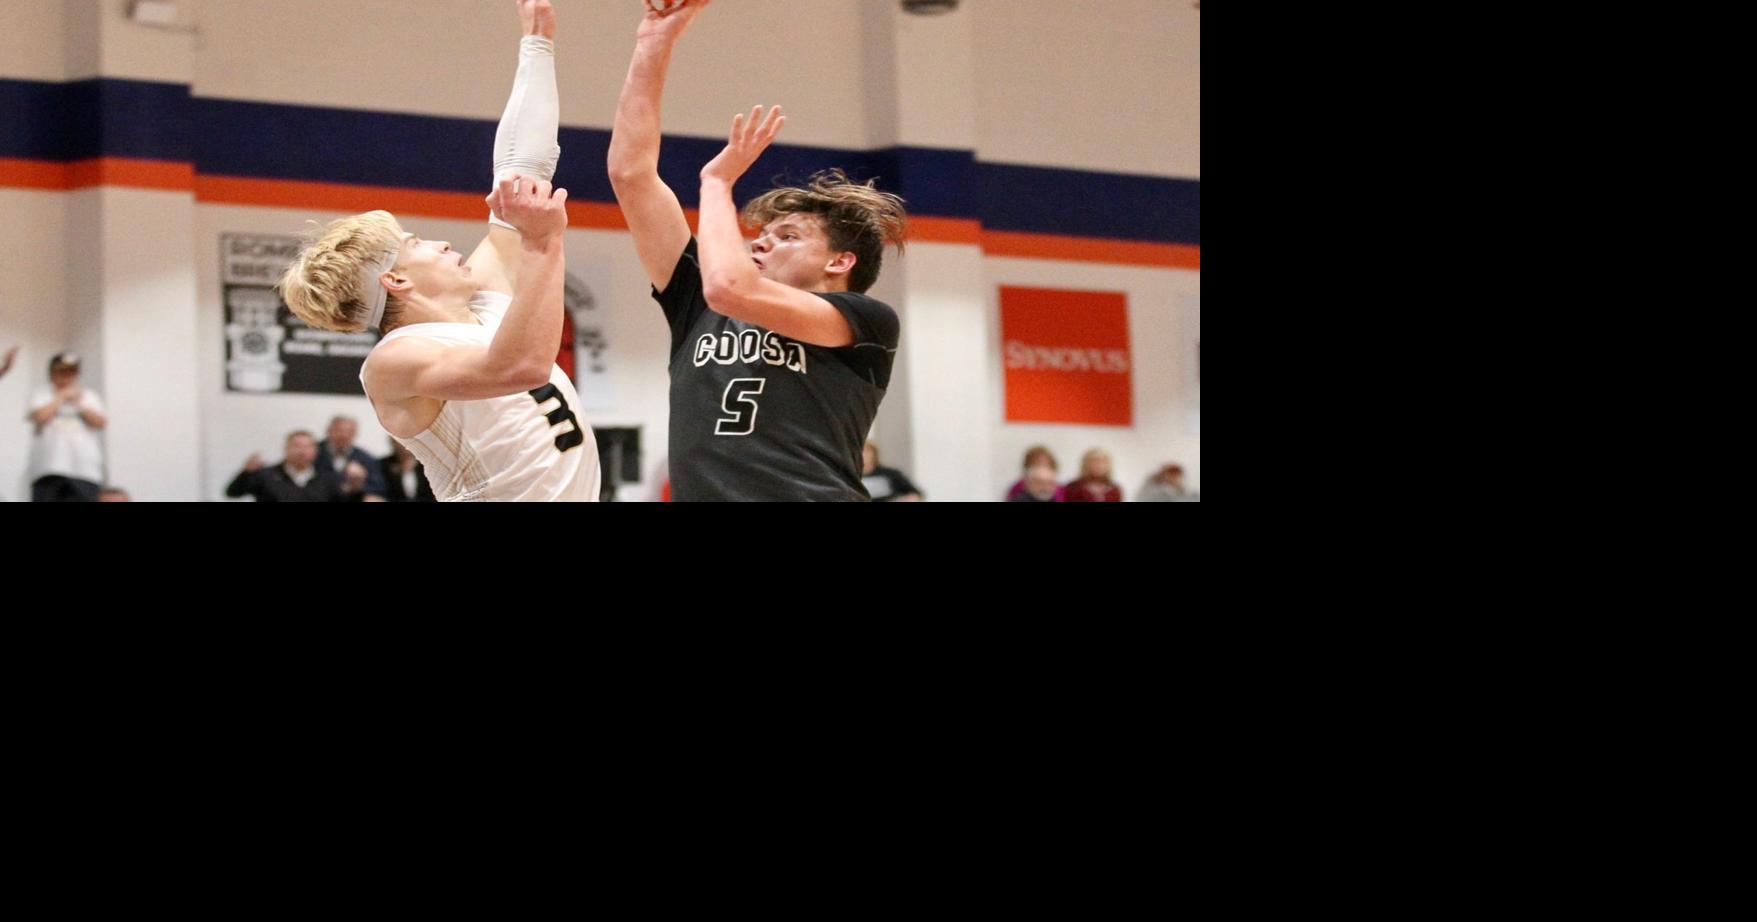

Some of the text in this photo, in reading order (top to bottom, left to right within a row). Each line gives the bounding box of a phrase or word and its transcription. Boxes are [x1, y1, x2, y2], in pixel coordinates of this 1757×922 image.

[693, 329, 807, 374] COOSA
[528, 382, 584, 453] 3
[714, 378, 766, 436] 5
